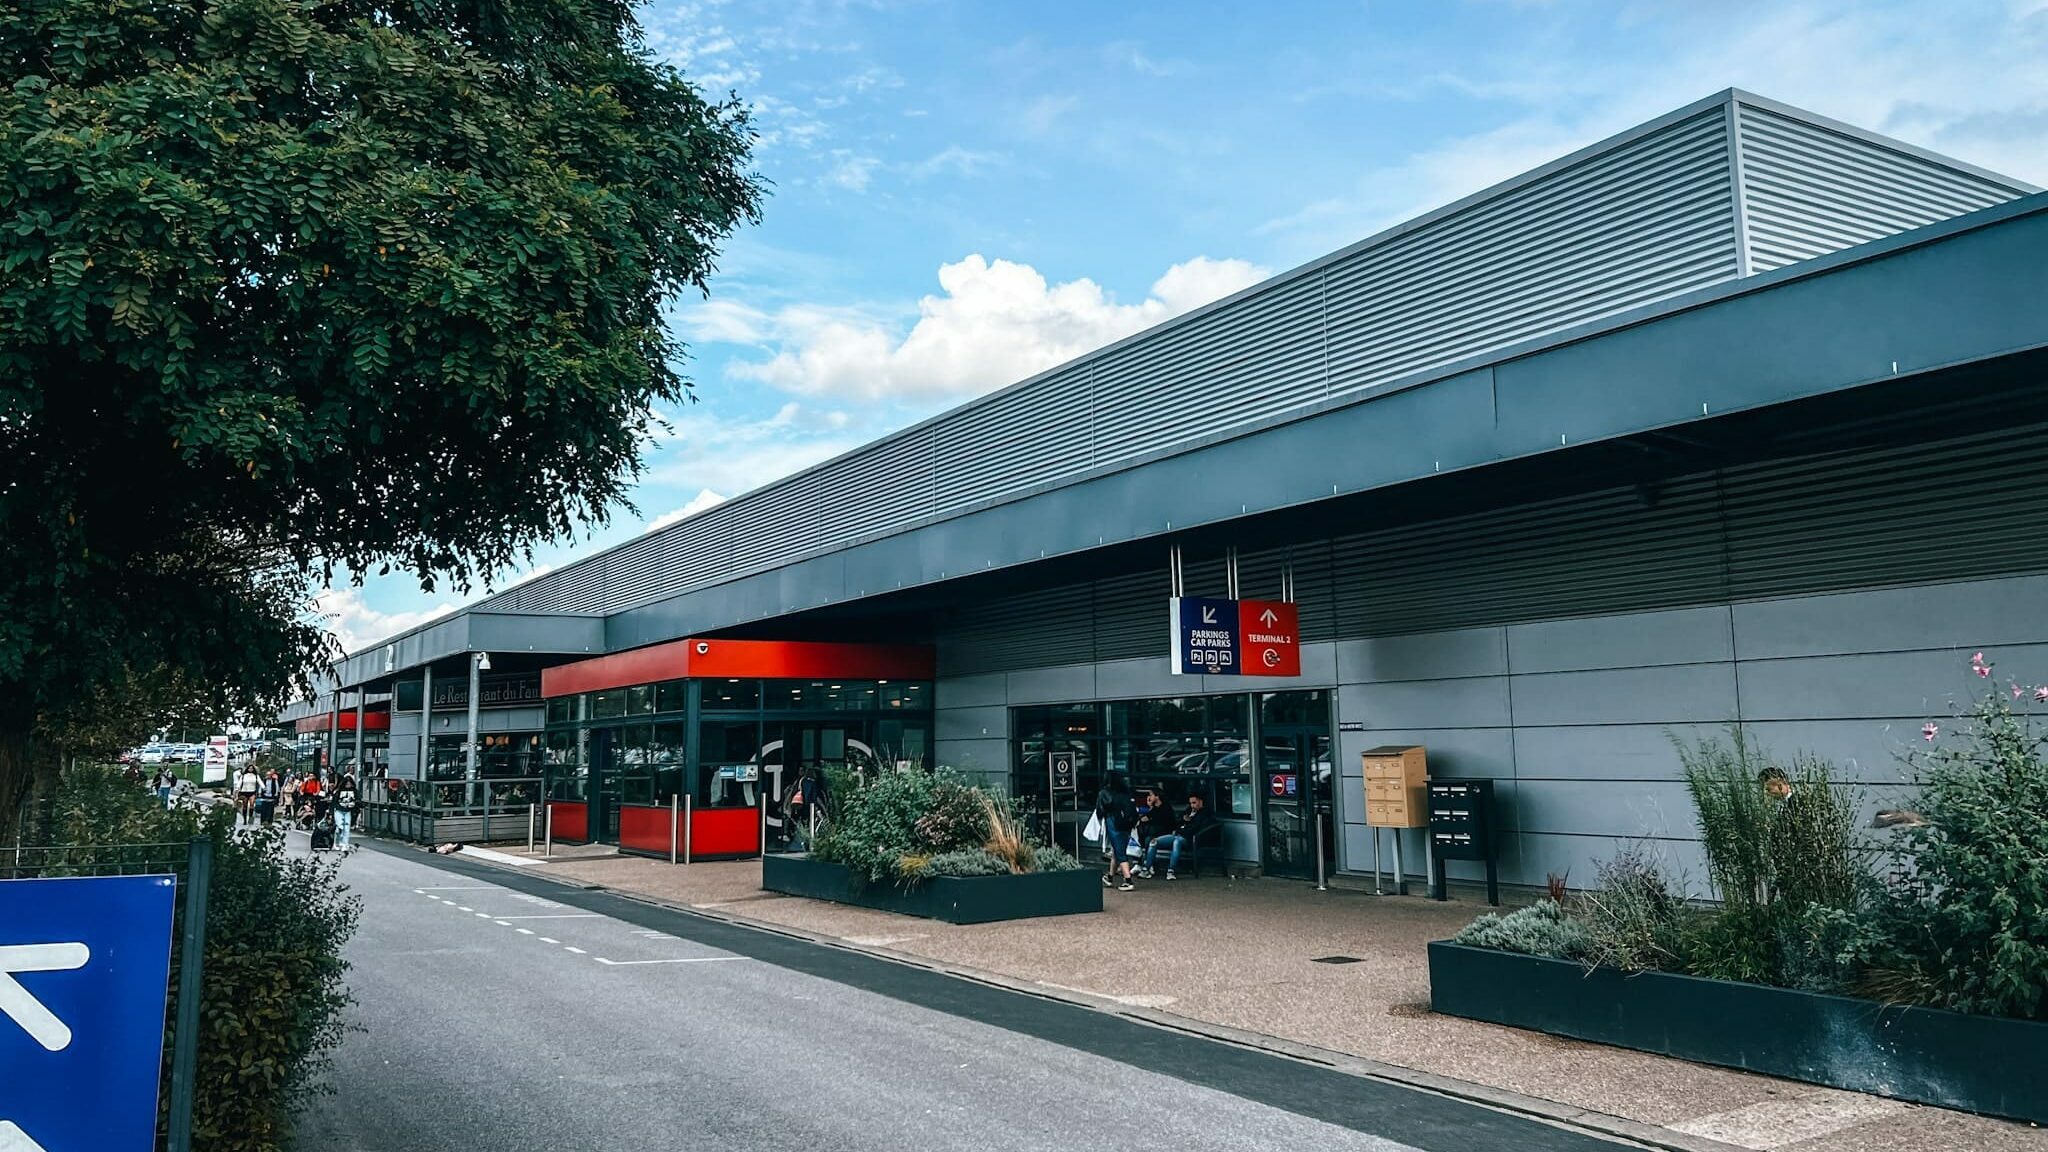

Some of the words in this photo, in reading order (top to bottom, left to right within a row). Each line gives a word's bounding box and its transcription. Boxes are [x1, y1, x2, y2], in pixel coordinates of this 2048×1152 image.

[1191, 630, 1229, 639] PARKINGS
[1248, 634, 1285, 643] TERMINAL
[1190, 638, 1206, 647] CAR
[1207, 639, 1231, 647] PARKS
[433, 685, 446, 704] Le
[446, 684, 501, 703] Restrant
[503, 680, 517, 700] du
